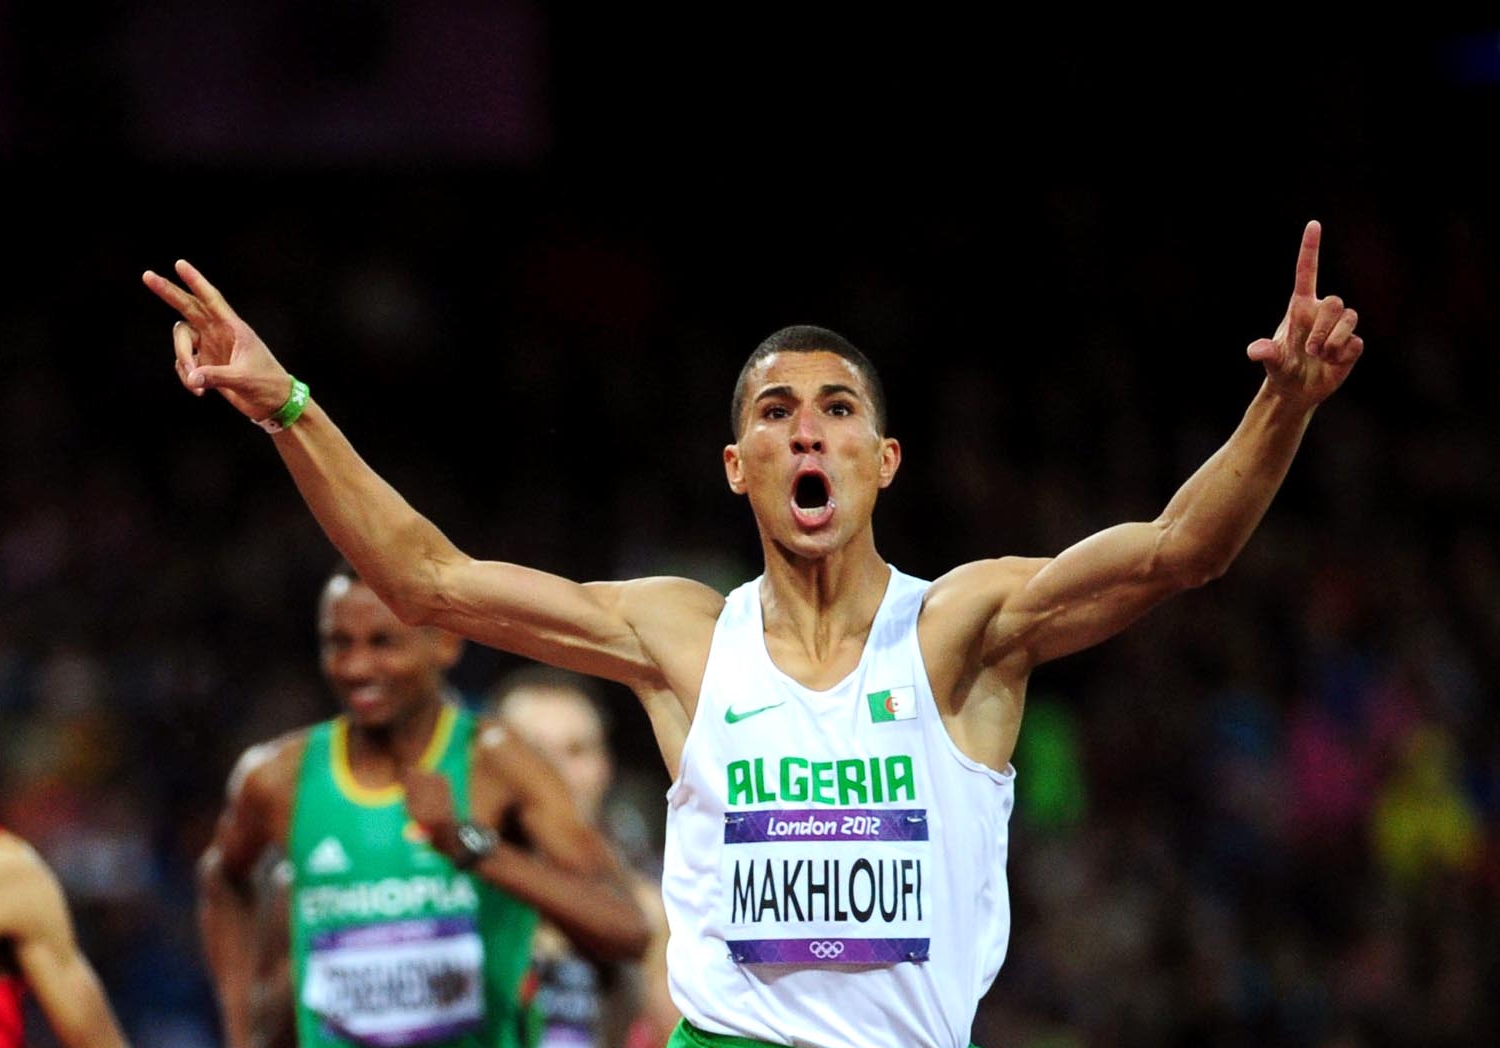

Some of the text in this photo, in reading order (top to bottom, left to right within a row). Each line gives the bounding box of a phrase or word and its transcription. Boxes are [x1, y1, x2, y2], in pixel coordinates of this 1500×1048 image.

[727, 755, 916, 806] ALGERIA
[767, 816, 881, 836] London 2012
[731, 858, 923, 923] MAKHLOUFI
